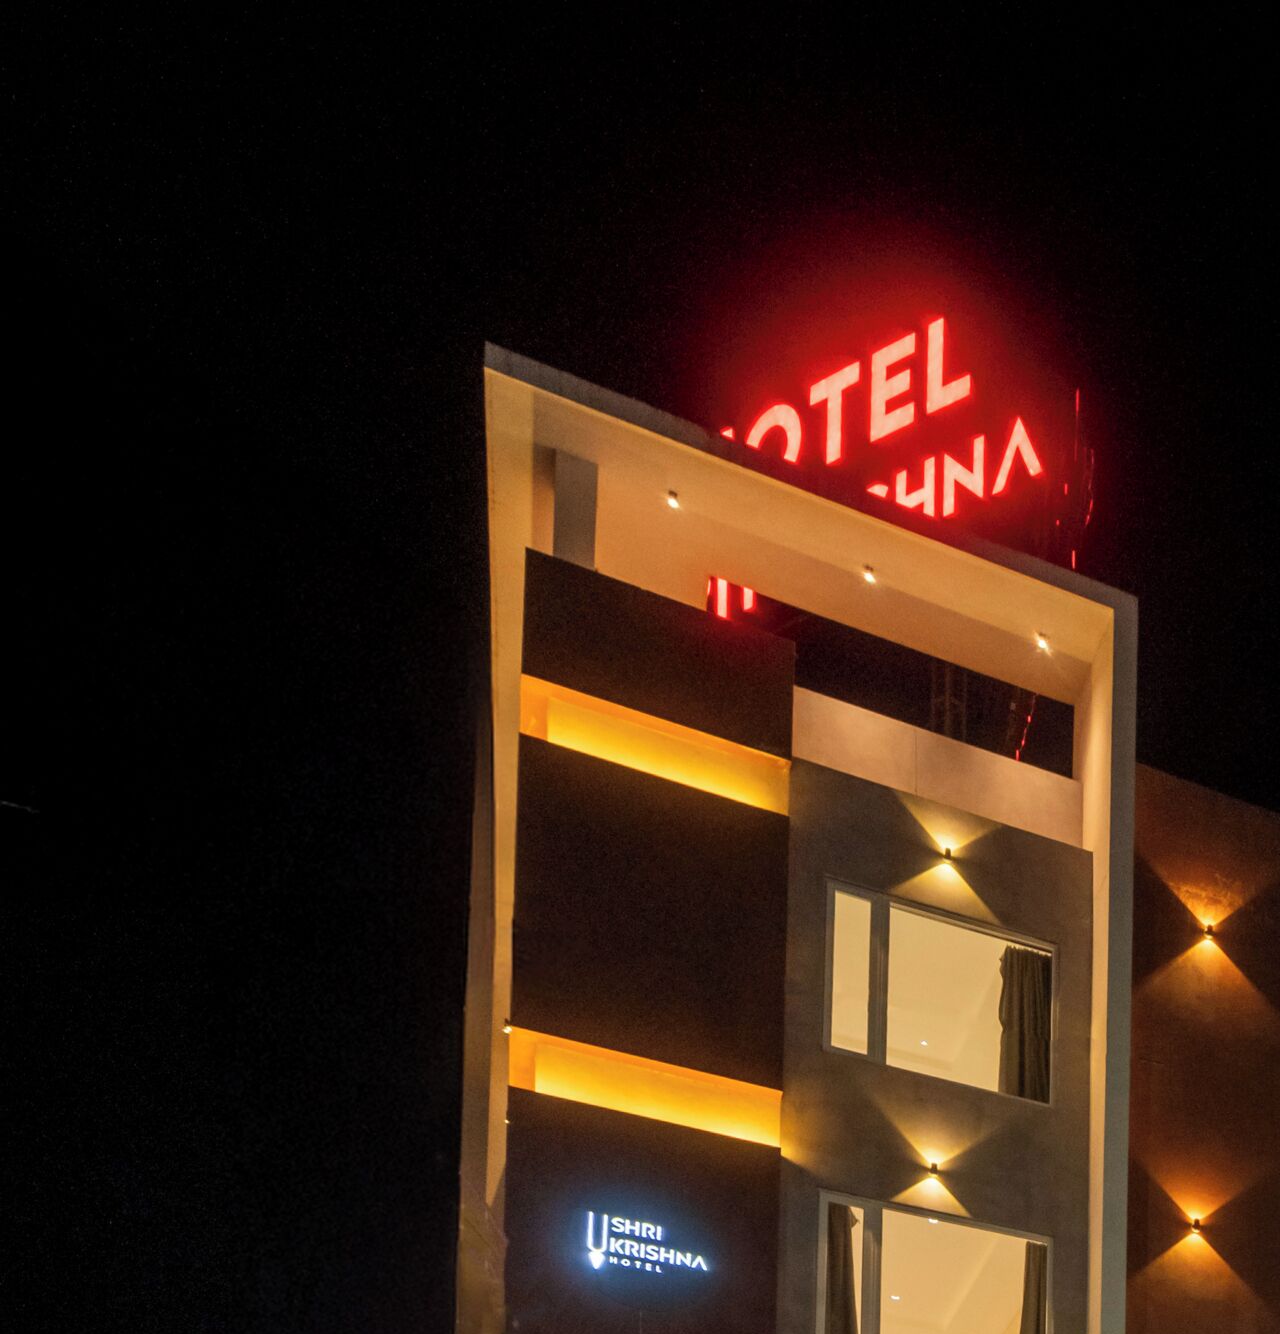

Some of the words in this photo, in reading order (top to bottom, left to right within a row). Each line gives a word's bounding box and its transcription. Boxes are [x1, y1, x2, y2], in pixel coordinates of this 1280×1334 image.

[720, 316, 972, 465] OTEL
[611, 1217, 662, 1241] SHRI
[609, 1237, 708, 1271] KRISHNA
[609, 1256, 662, 1273] HOTEL
